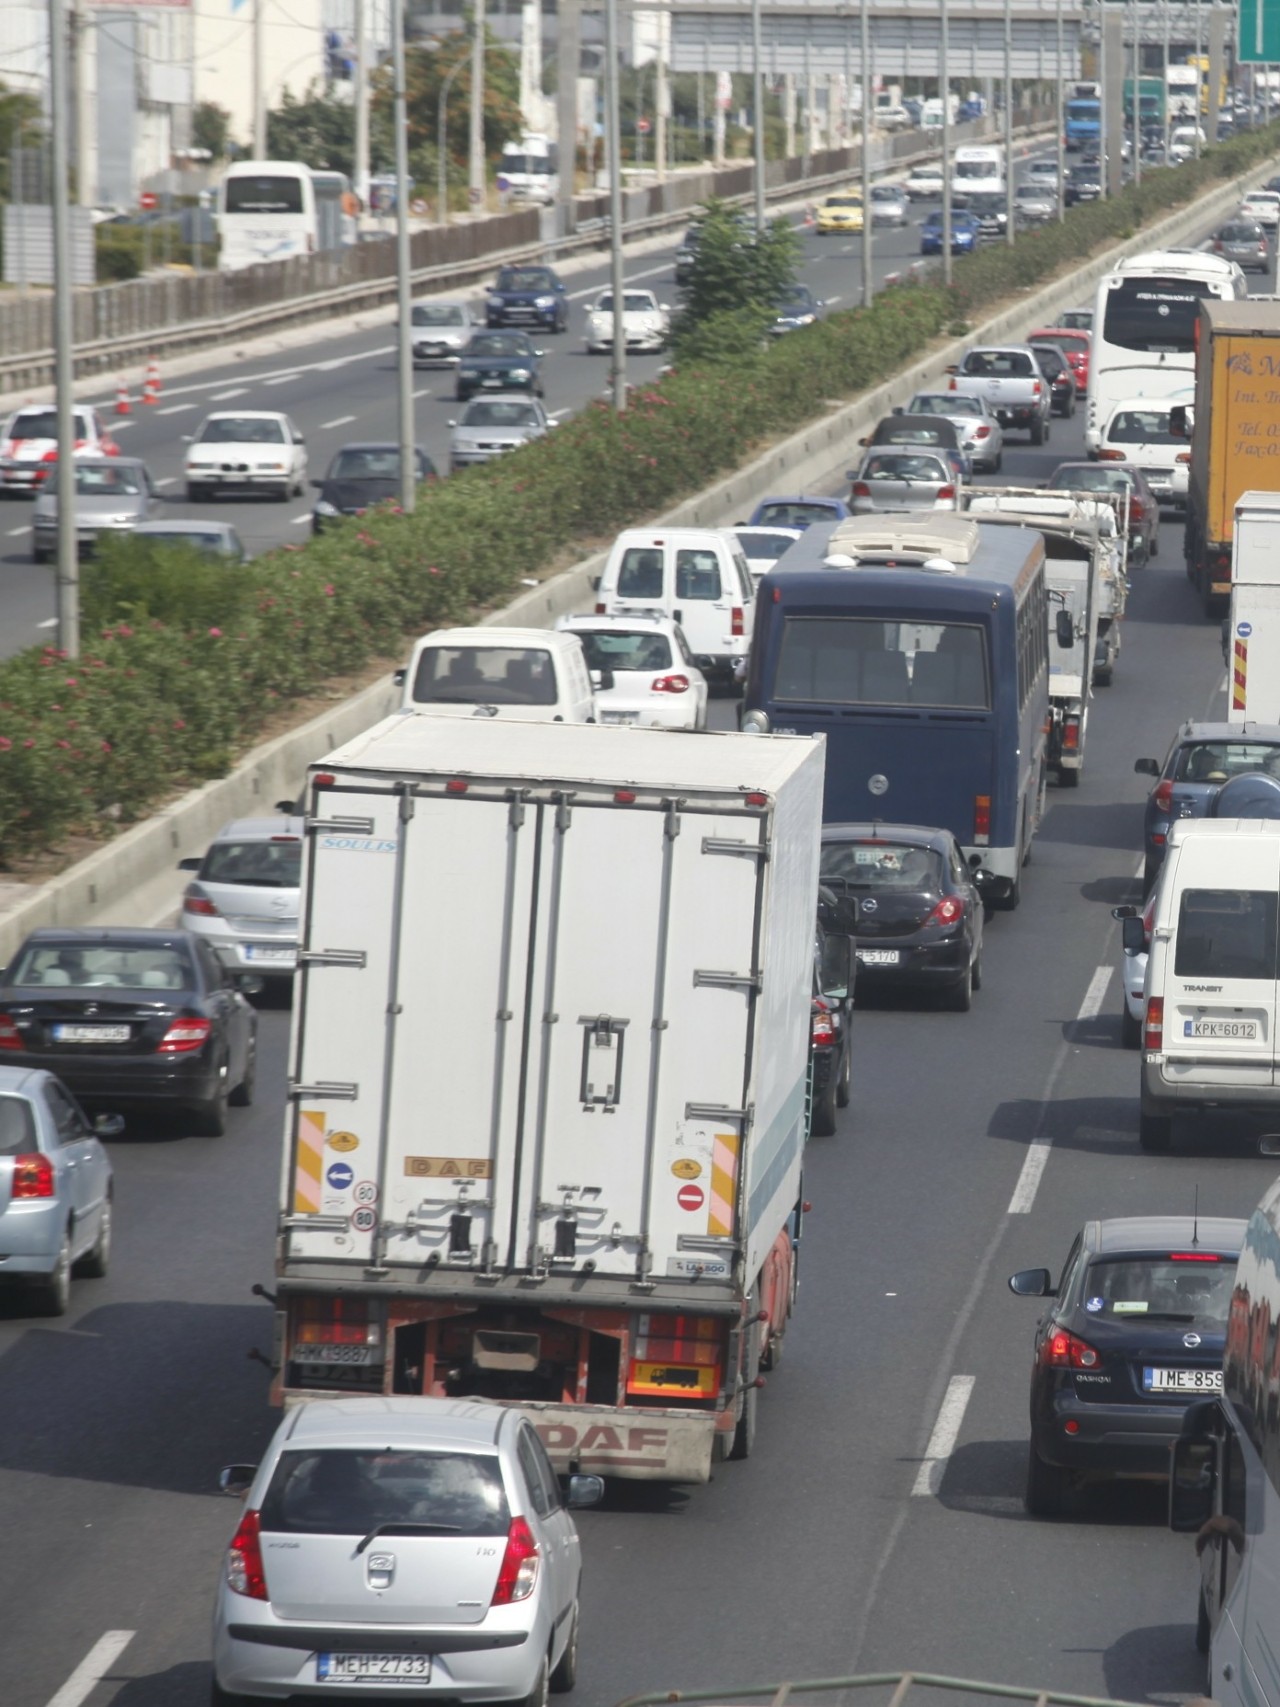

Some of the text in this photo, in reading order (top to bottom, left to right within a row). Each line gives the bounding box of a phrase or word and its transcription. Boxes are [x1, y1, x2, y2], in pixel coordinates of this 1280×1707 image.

[322, 837, 397, 852] SOULIS
[1183, 984, 1223, 993] TRANSIT
[1194, 1023, 1255, 1037] KPK-6012
[411, 1159, 486, 1176] DAF
[357, 1211, 372, 1226] 80
[536, 1424, 668, 1451] DAF
